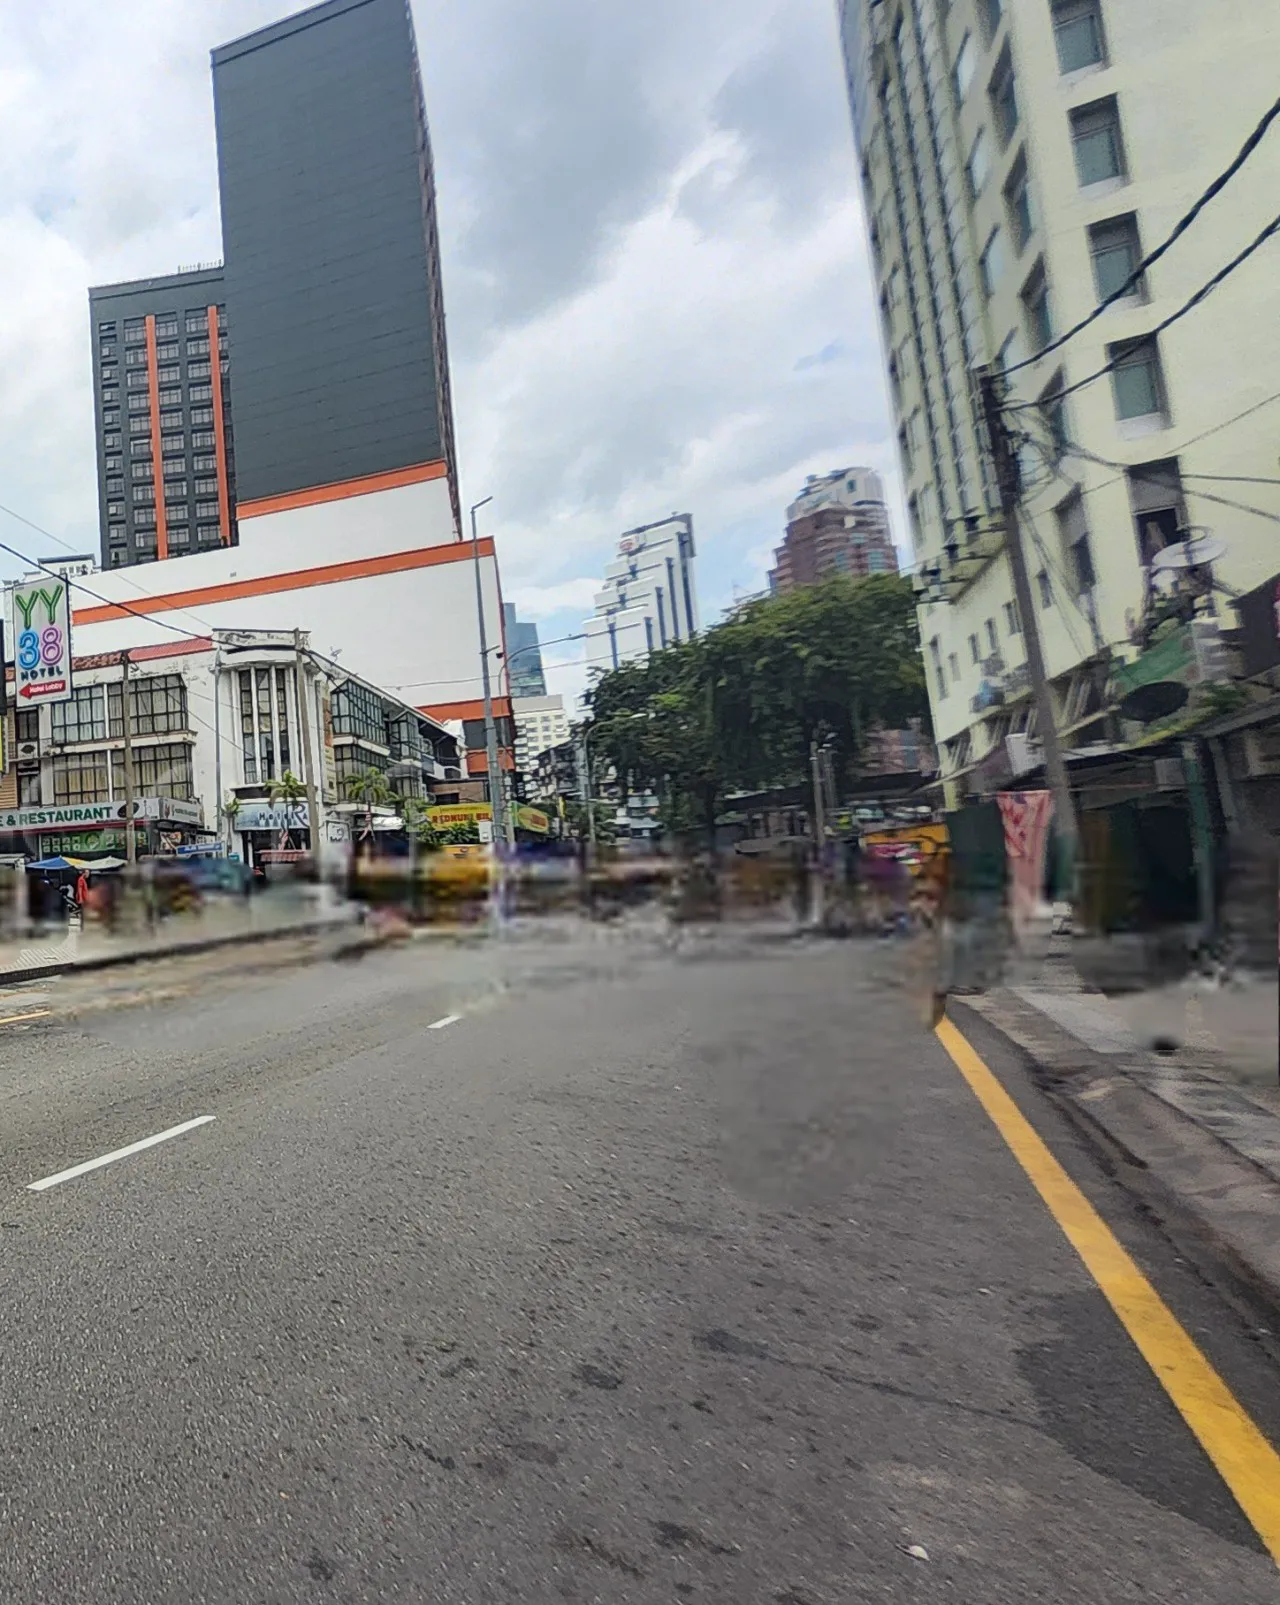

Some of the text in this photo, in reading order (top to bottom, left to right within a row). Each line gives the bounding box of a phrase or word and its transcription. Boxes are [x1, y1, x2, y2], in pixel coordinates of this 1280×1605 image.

[19, 627, 63, 670] 38
[20, 666, 63, 681] HOTEL
[6, 814, 17, 828] &
[19, 806, 114, 827] RESTAURANT
